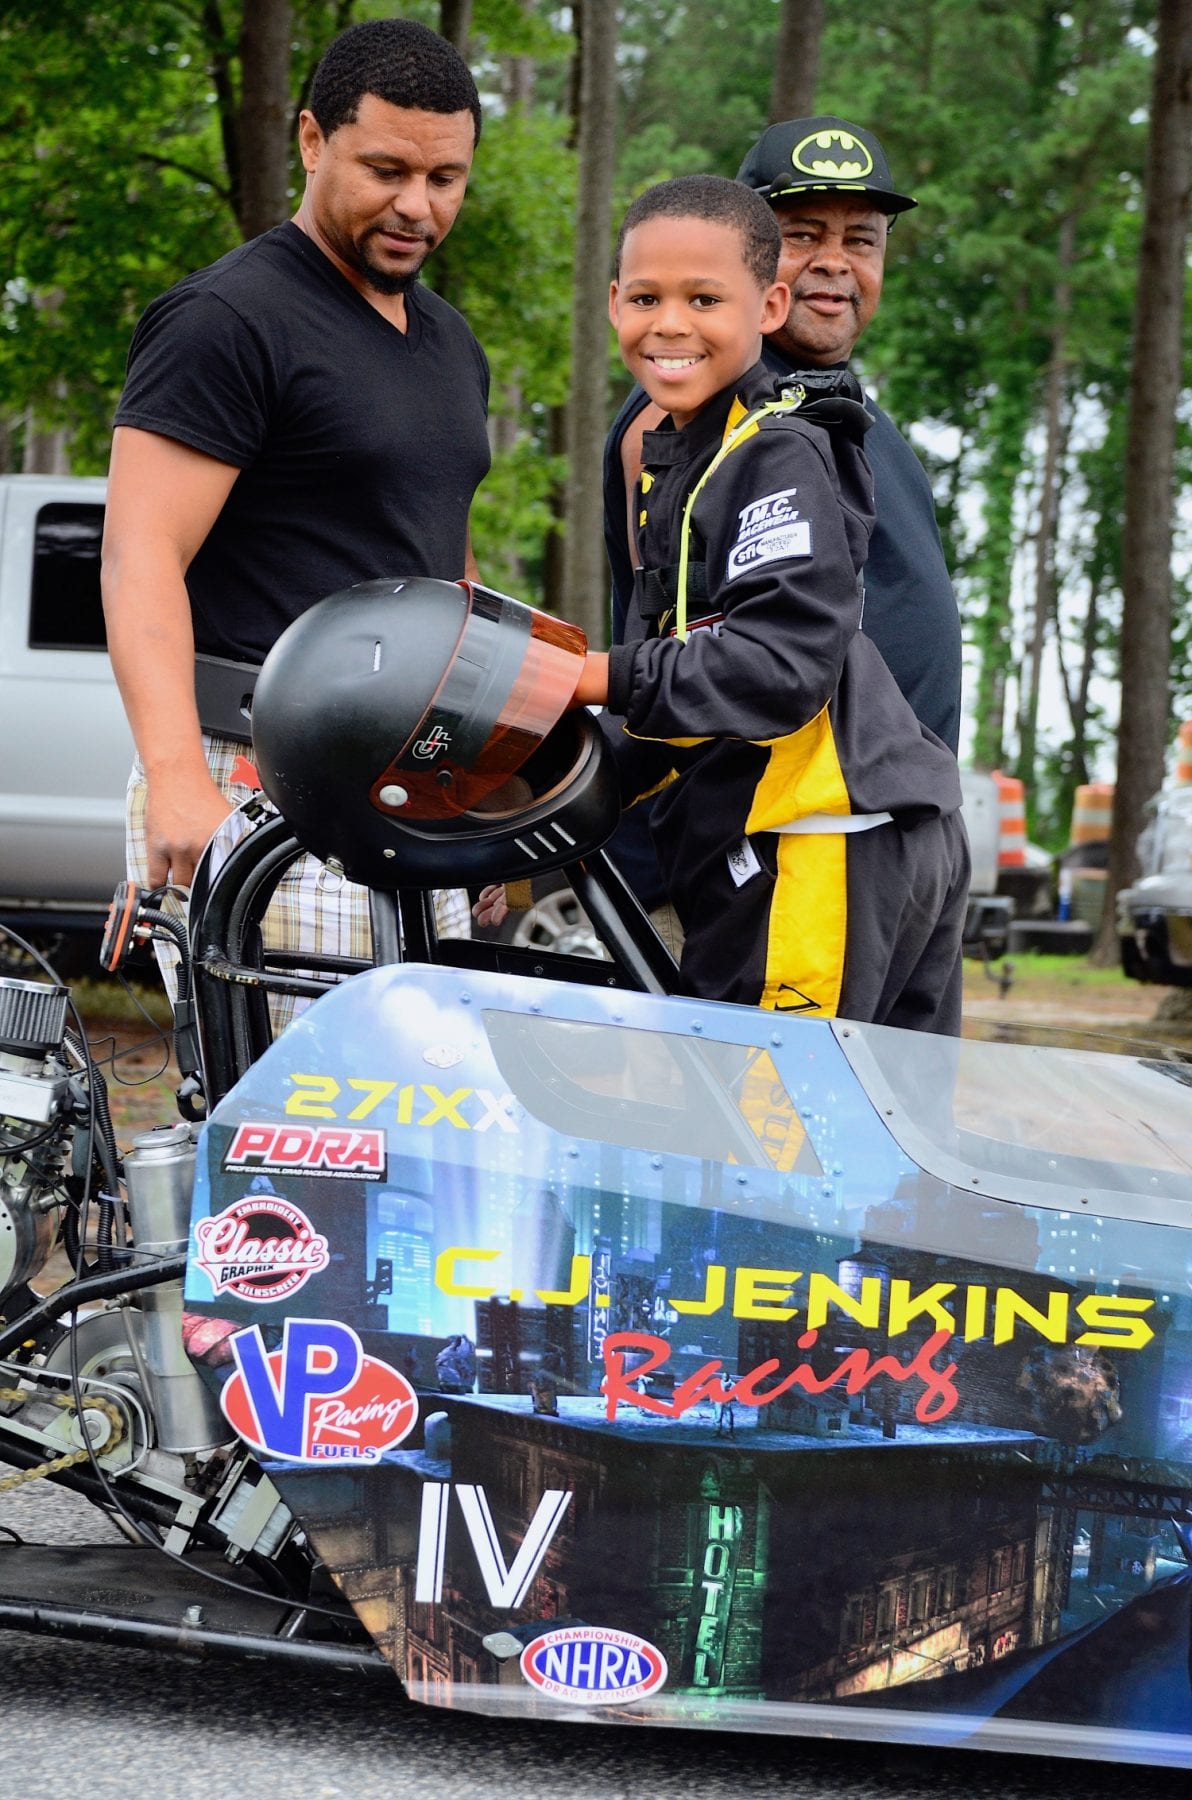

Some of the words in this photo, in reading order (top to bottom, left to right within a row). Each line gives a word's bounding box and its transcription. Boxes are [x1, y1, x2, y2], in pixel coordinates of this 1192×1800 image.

[226, 1124, 385, 1171] PDRA
[236, 1202, 302, 1226] EMBROIDERY
[201, 1217, 324, 1262] Classic
[220, 1264, 274, 1284] GRAPHIX
[238, 1272, 300, 1297] SILKSCREEN
[434, 1246, 611, 1308] C.J.
[668, 1264, 1156, 1350] JENKINS
[231, 1319, 362, 1460] VP
[602, 1328, 961, 1424] Racing
[312, 1394, 413, 1442] Racing
[312, 1443, 378, 1460] FUELS
[415, 1481, 573, 1609] IV
[692, 1504, 734, 1687] HOTEL
[547, 1630, 640, 1649] CHAMPIONSHIP
[545, 1642, 643, 1689] NHRA
[544, 1680, 579, 1699] DRAG
[586, 1688, 634, 1701] RACING
